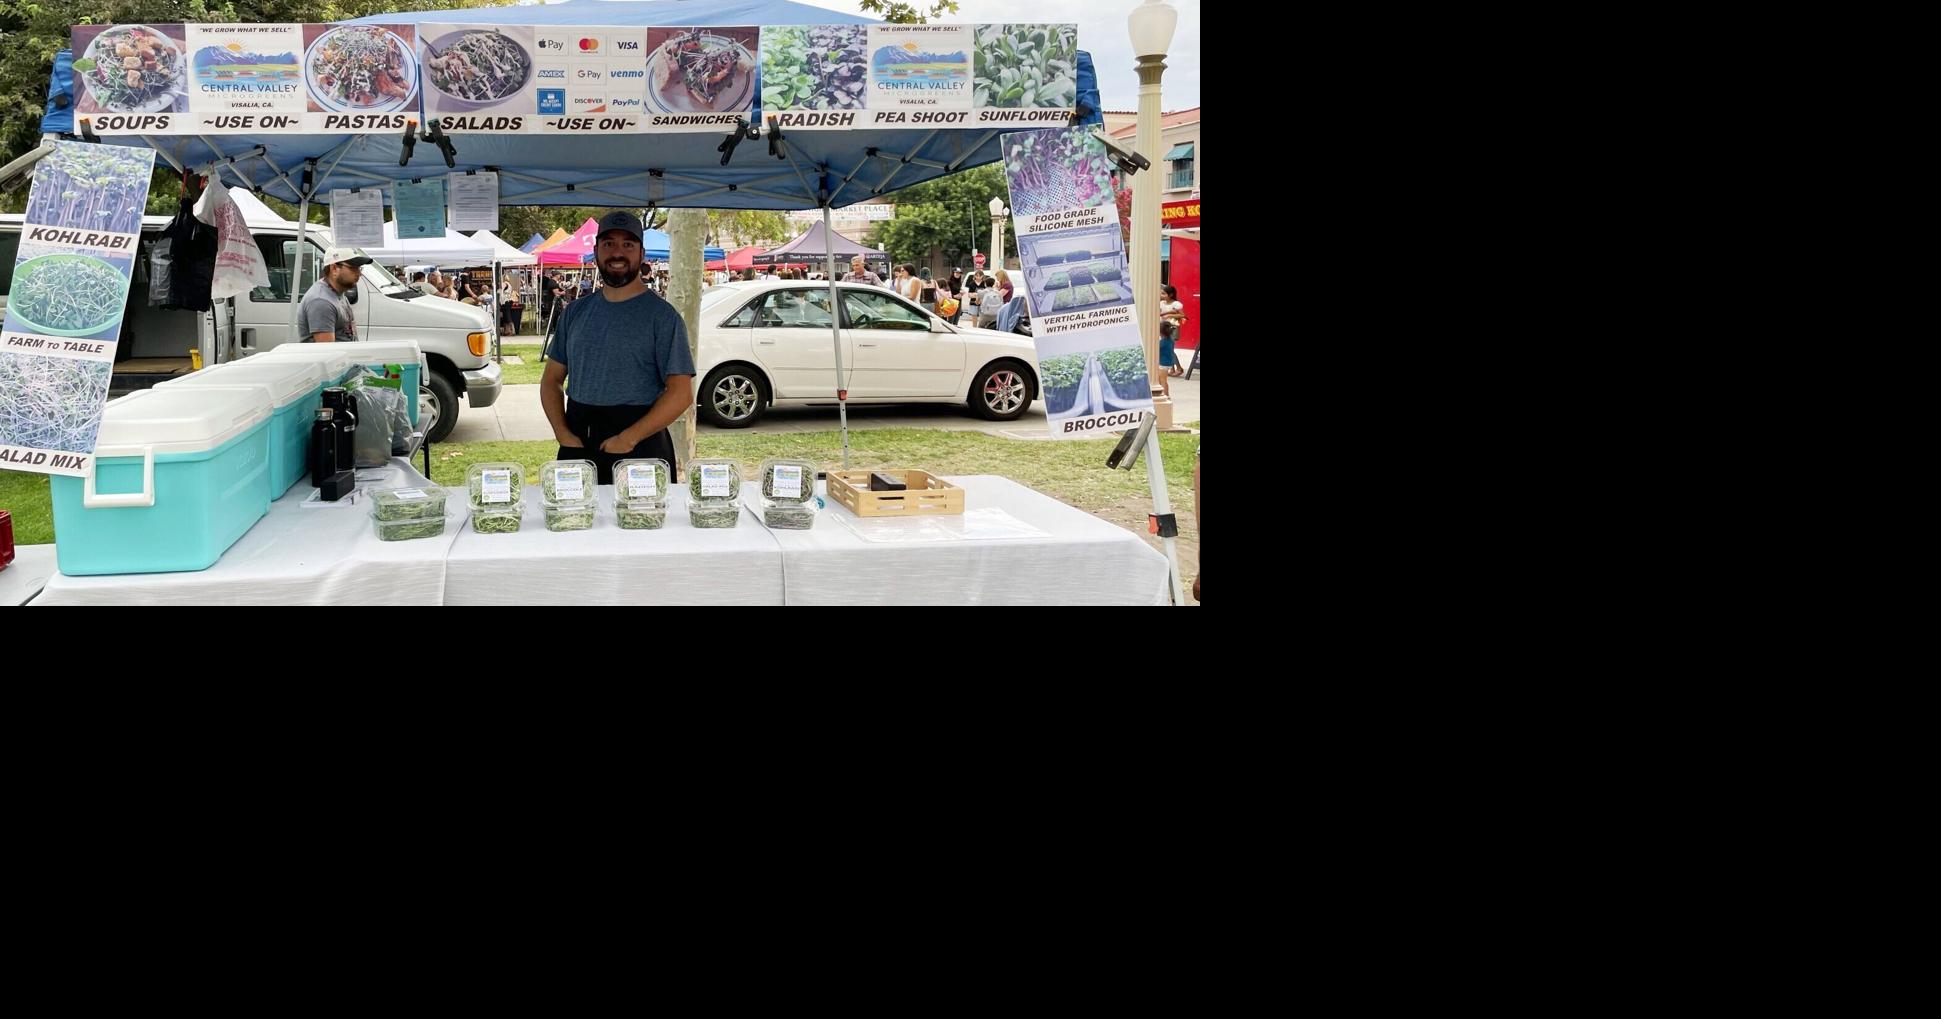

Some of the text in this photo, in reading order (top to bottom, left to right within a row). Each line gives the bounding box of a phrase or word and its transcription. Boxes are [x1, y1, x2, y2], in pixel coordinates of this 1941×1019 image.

[548, 40, 563, 50] Pay
[587, 71, 601, 79] Pay
[204, 116, 299, 129] ~USE ON~
[324, 115, 405, 129] PASTAS
[652, 115, 742, 125] SANDWICHES
[779, 113, 854, 126] RADISH
[874, 112, 967, 123] PEA SHOOT
[979, 111, 1070, 121] SUNFLOWER
[95, 116, 169, 130] SOUPS
[440, 117, 522, 130] SALADS
[547, 119, 636, 130] ~USE ON~
[1035, 208, 1096, 223] FOOD GRADE
[1162, 206, 1186, 219] ING
[1029, 217, 1104, 232] SILICONE MESH
[29, 228, 132, 249] KOHLRABI
[1044, 307, 1128, 324] VERTICAL FARMING
[1046, 316, 1130, 333] WITH HYDROPONICS
[8, 337, 45, 348] FARM
[64, 342, 104, 353] TABLE
[1064, 412, 1143, 433] BROCCOLI
[50, 455, 87, 469] MIX
